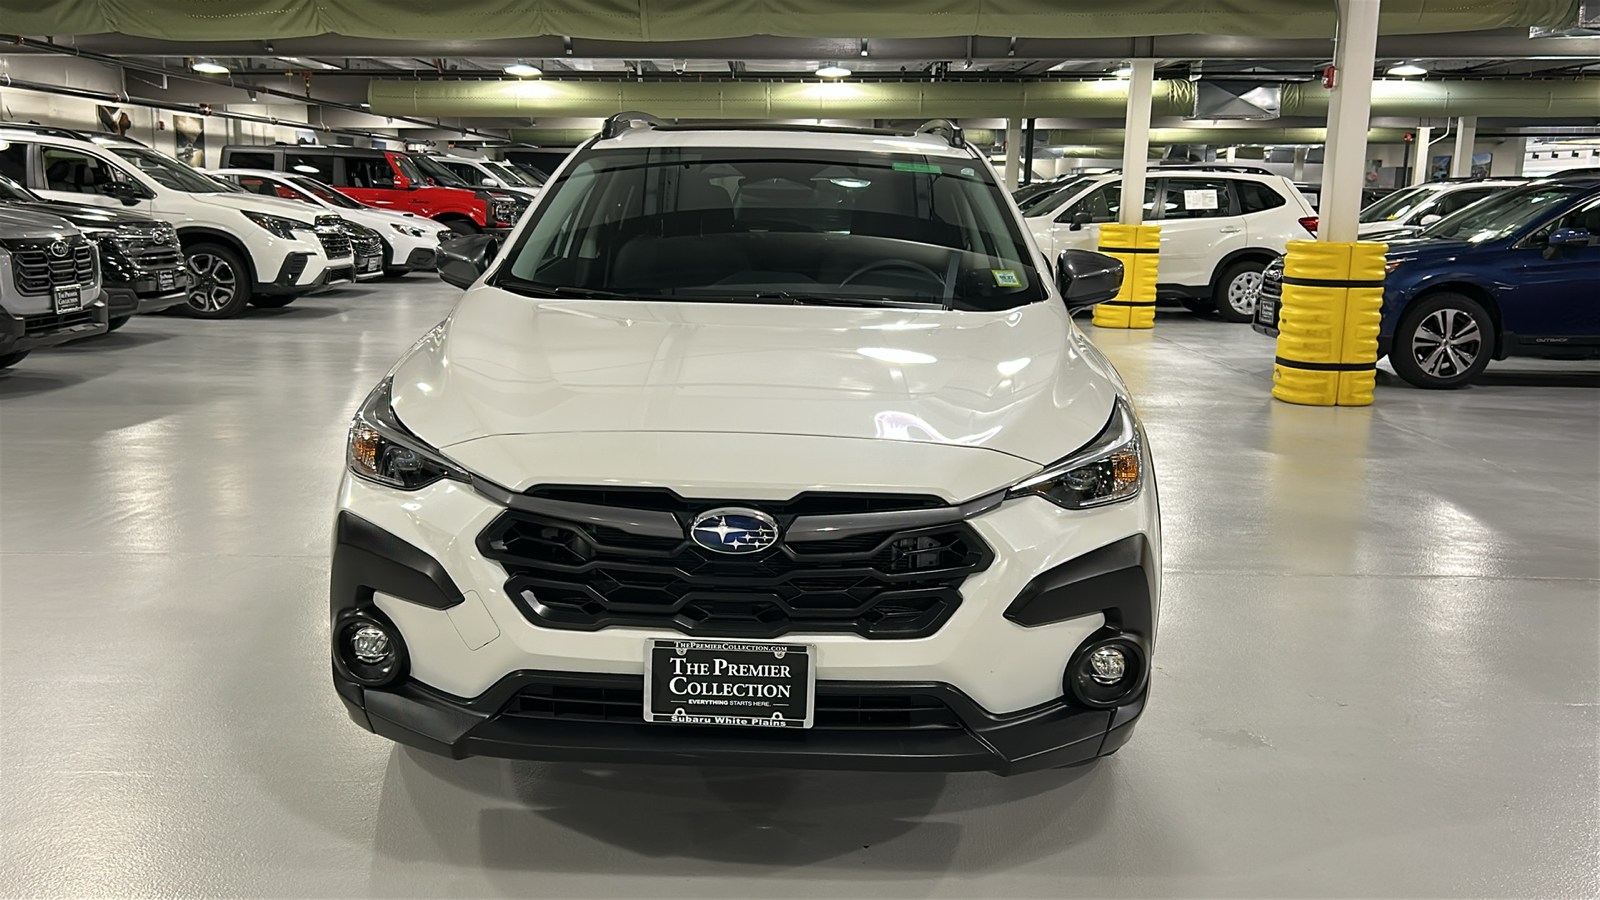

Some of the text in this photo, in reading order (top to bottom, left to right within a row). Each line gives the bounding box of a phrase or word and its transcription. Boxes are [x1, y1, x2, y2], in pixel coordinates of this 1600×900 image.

[670, 658, 792, 678] THE PREMIER
[669, 676, 791, 698] COLLECTION
[671, 715, 786, 727] Subaru White Plains
